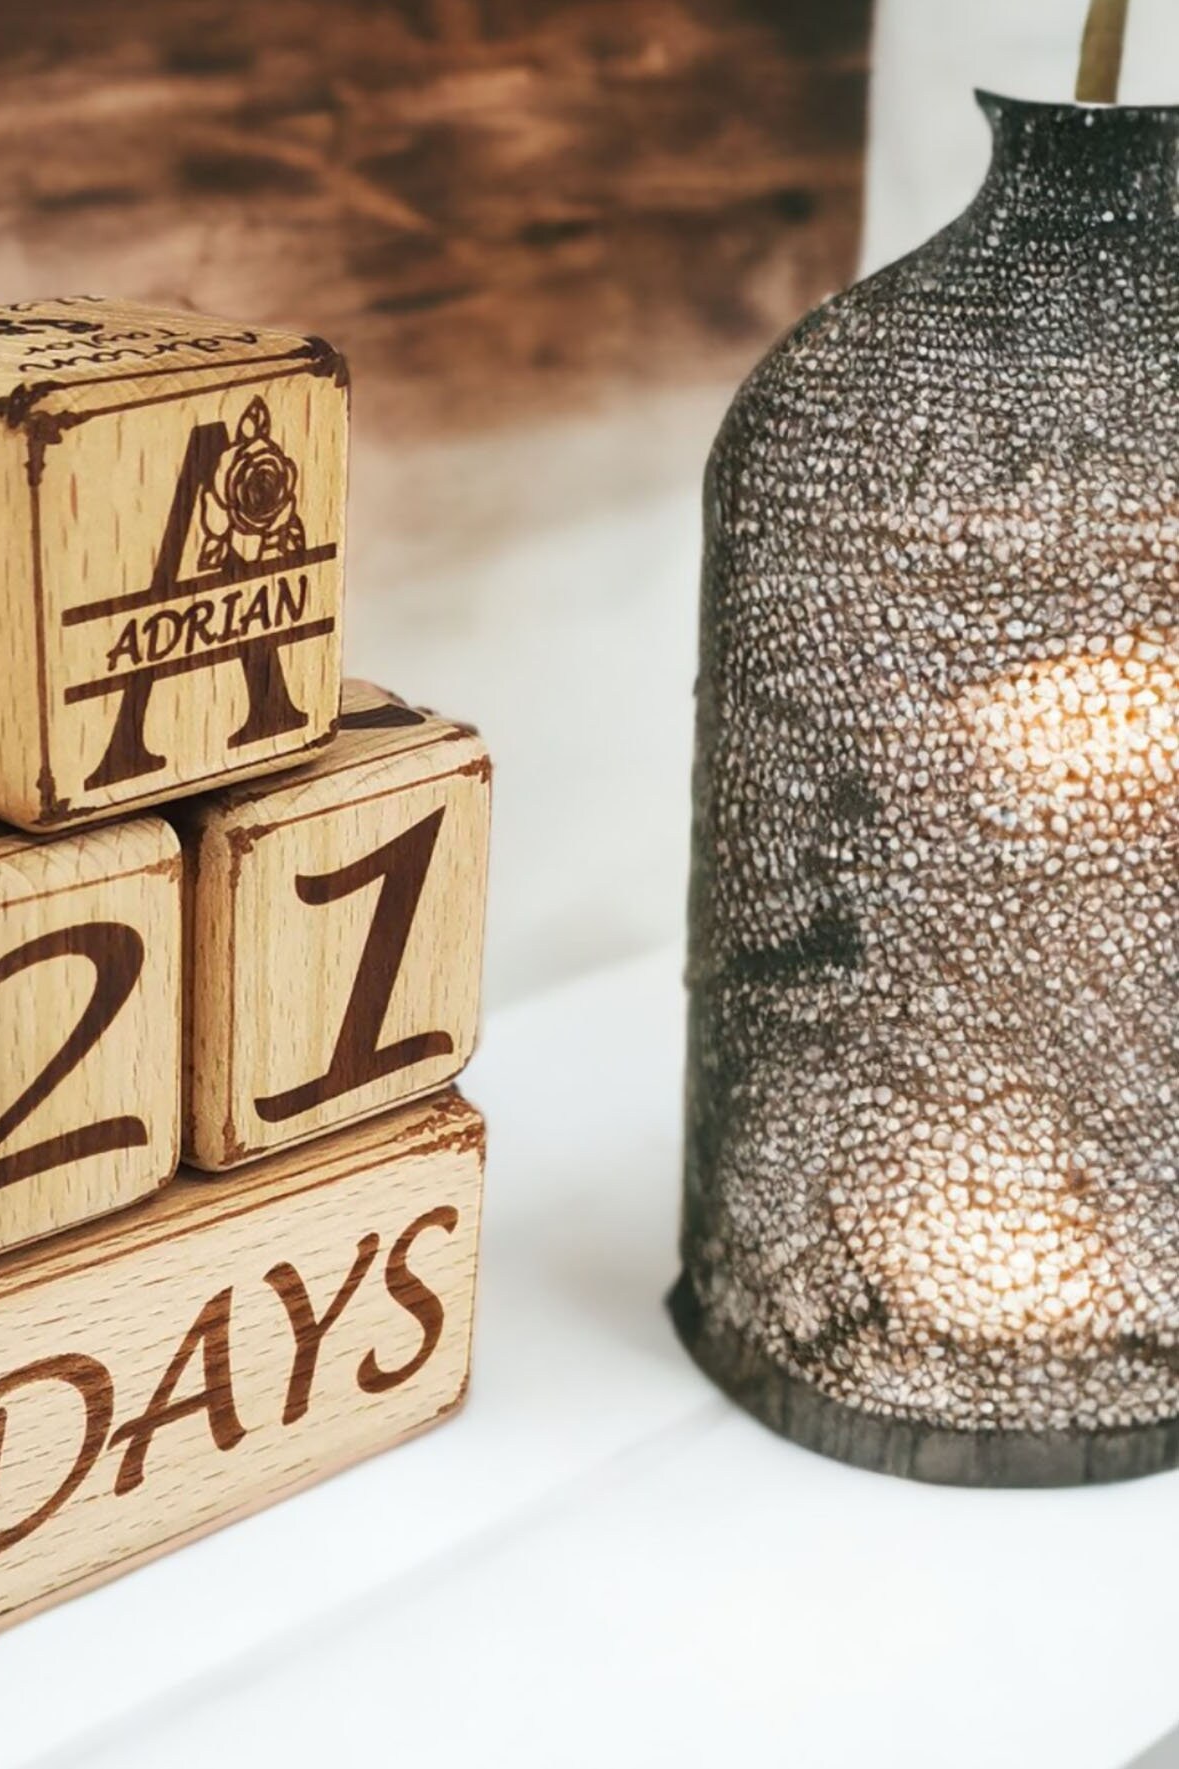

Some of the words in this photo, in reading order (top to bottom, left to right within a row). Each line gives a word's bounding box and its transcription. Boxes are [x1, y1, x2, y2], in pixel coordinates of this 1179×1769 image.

[17, 330, 260, 374] Adrian
[23, 327, 191, 356] Taylor
[106, 574, 308, 672] ADRIAN
